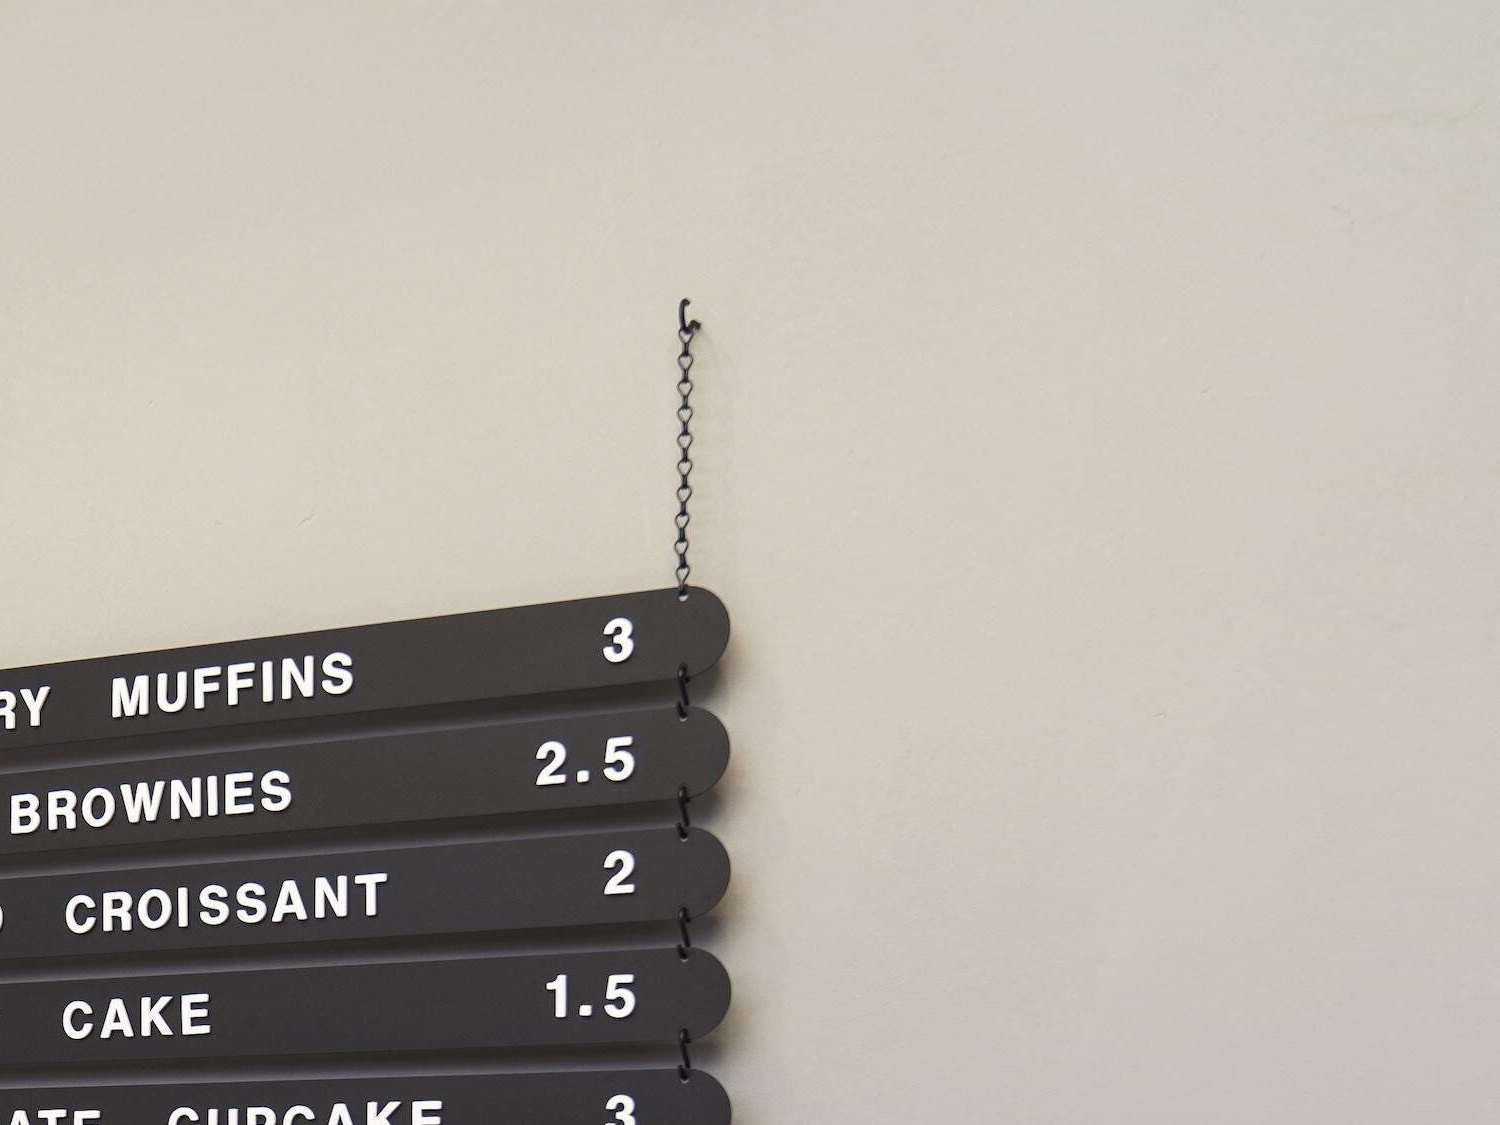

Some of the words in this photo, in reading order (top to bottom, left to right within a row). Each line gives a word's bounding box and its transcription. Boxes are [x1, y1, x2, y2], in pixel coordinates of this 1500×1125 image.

[111, 651, 355, 718] MUFFINS
[602, 616, 634, 664] 3
[9, 769, 293, 835] BROWNIES
[535, 735, 636, 786] 2.5
[64, 872, 388, 934] CROISSANT
[603, 849, 636, 895] 2
[62, 993, 211, 1040] CAKE
[545, 973, 636, 1018] 1.5
